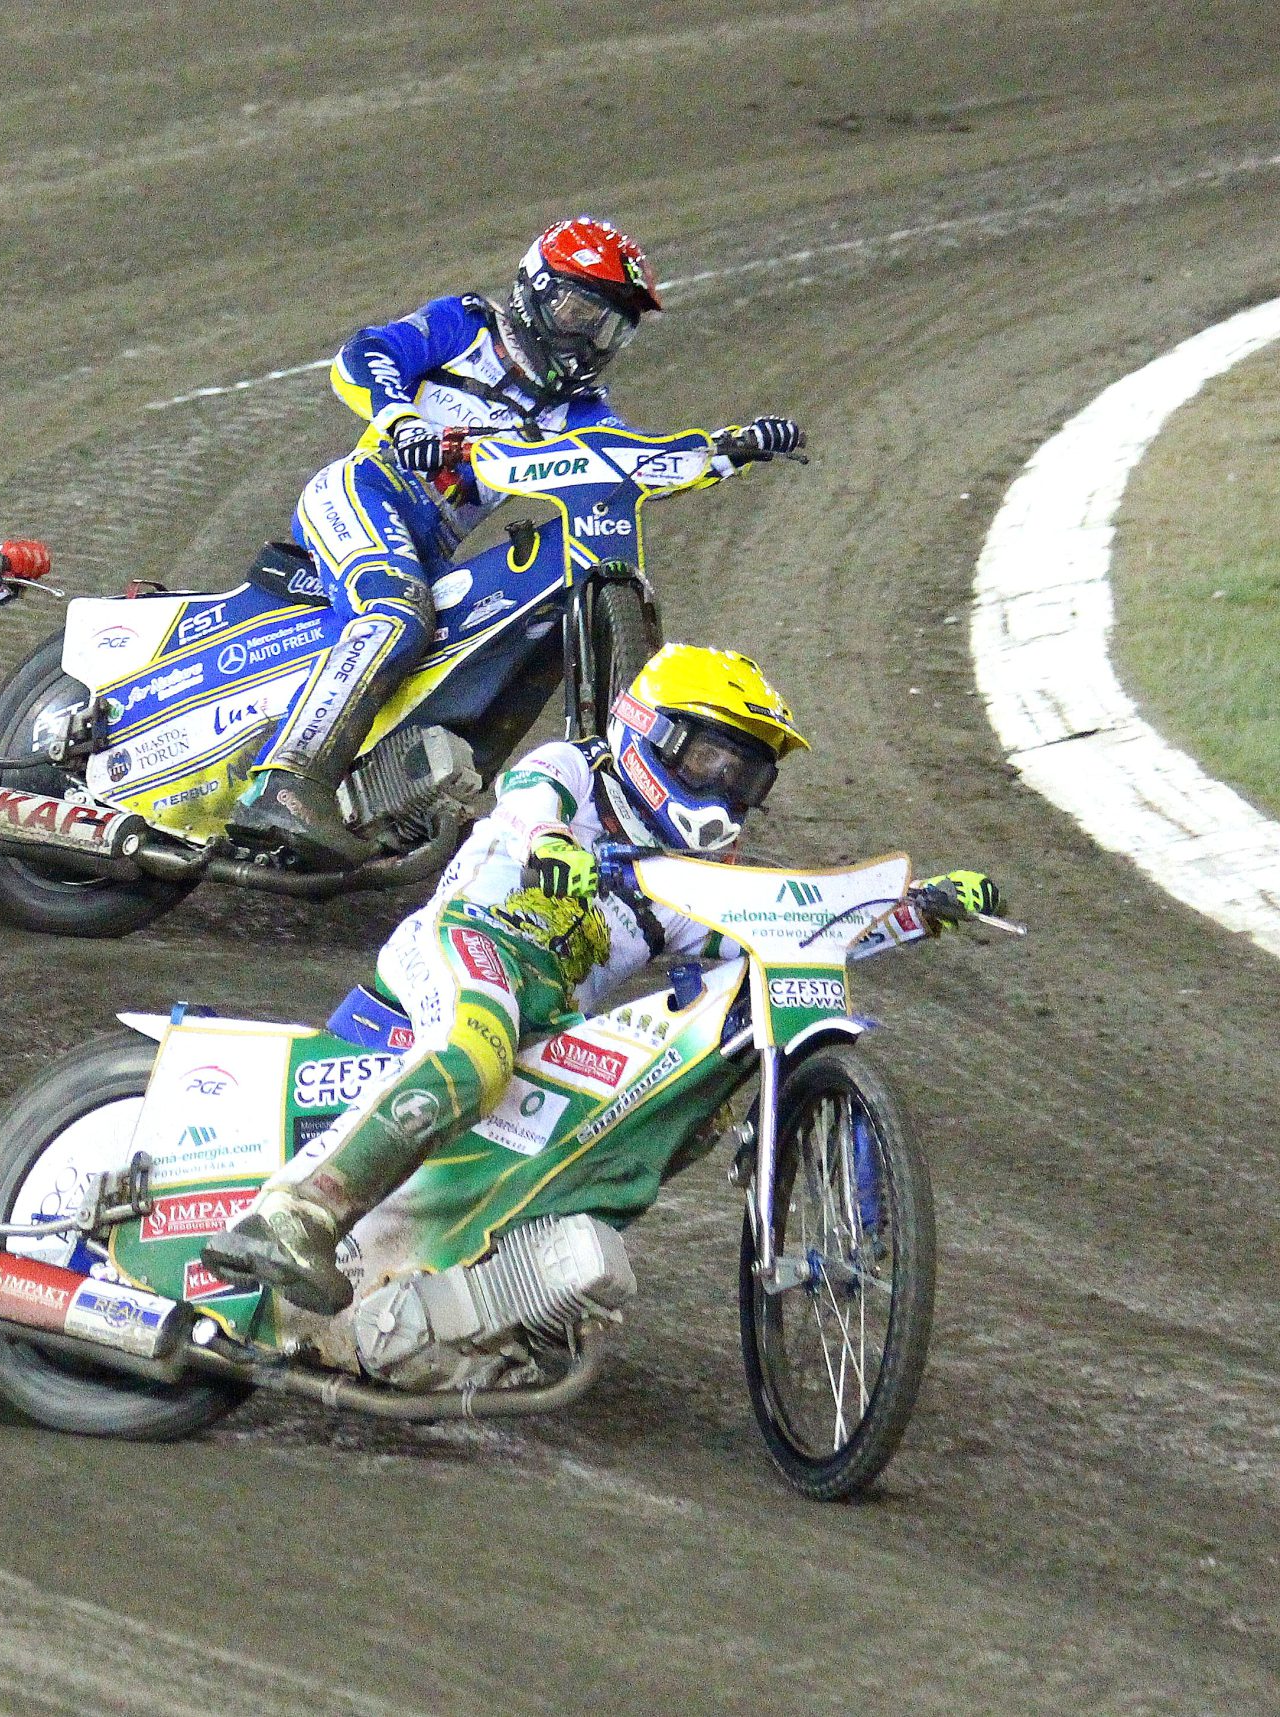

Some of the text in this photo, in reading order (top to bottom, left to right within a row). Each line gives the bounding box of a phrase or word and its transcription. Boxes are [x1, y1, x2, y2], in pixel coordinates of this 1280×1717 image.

[427, 387, 484, 428] APATO
[507, 457, 590, 484] LAVOR
[573, 515, 632, 538] Nice
[178, 602, 227, 639] FST
[97, 636, 130, 648] PGE
[249, 627, 325, 665] AUTO FRELIK
[169, 780, 219, 806] ERBUD
[568, 1043, 622, 1075] IMPAKT
[185, 1079, 228, 1096] PGE
[297, 1086, 362, 1104] CHO
[152, 1142, 262, 1167] ona-energia.com
[2, 1274, 70, 1305] IMPAKT
